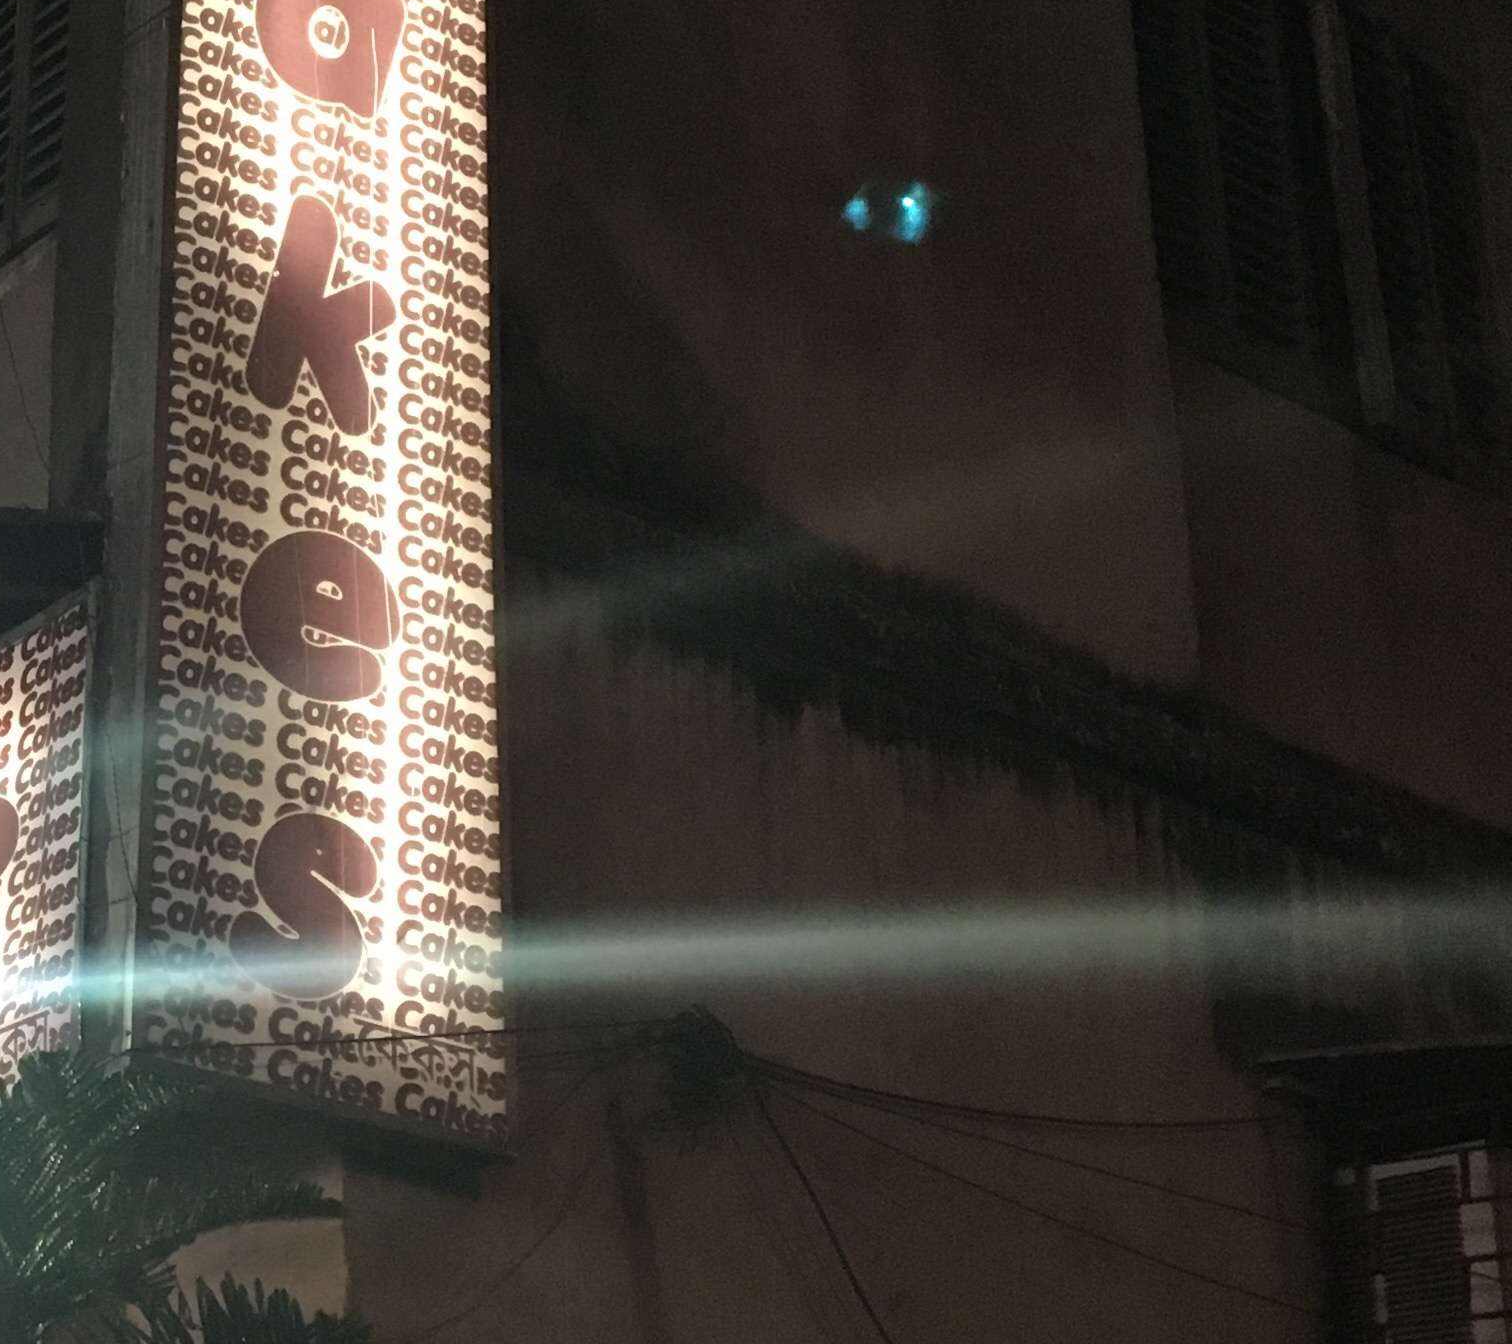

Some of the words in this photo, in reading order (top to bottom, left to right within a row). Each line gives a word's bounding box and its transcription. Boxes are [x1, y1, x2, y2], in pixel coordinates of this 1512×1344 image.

[180, 27, 278, 89] Cakes
[179, 60, 279, 123] Cakes
[291, 108, 389, 171] Cakes
[176, 128, 278, 191] Cakes
[178, 94, 277, 157] Cakes
[290, 142, 389, 204] Cakes
[175, 163, 277, 226] Cakes
[174, 193, 276, 261] Cakes
[168, 375, 272, 440] Cakes
[281, 420, 387, 483] Cakes
[166, 408, 271, 477] Cakes
[280, 456, 386, 518] Cakes
[20, 636, 87, 695] Cakes
[157, 641, 267, 708] Cakes
[19, 669, 87, 728] Cakes
[17, 704, 83, 760] Cakes
[156, 683, 266, 747] Cakes
[276, 723, 387, 785] Cakes
[15, 738, 80, 794] Cakes
[154, 764, 264, 827] Cakes
[155, 723, 265, 787] Cakes
[275, 763, 386, 824] Cakes
[5, 866, 80, 931] Cakes
[7, 838, 80, 897] Cakes
[2, 913, 76, 966] Cakes
